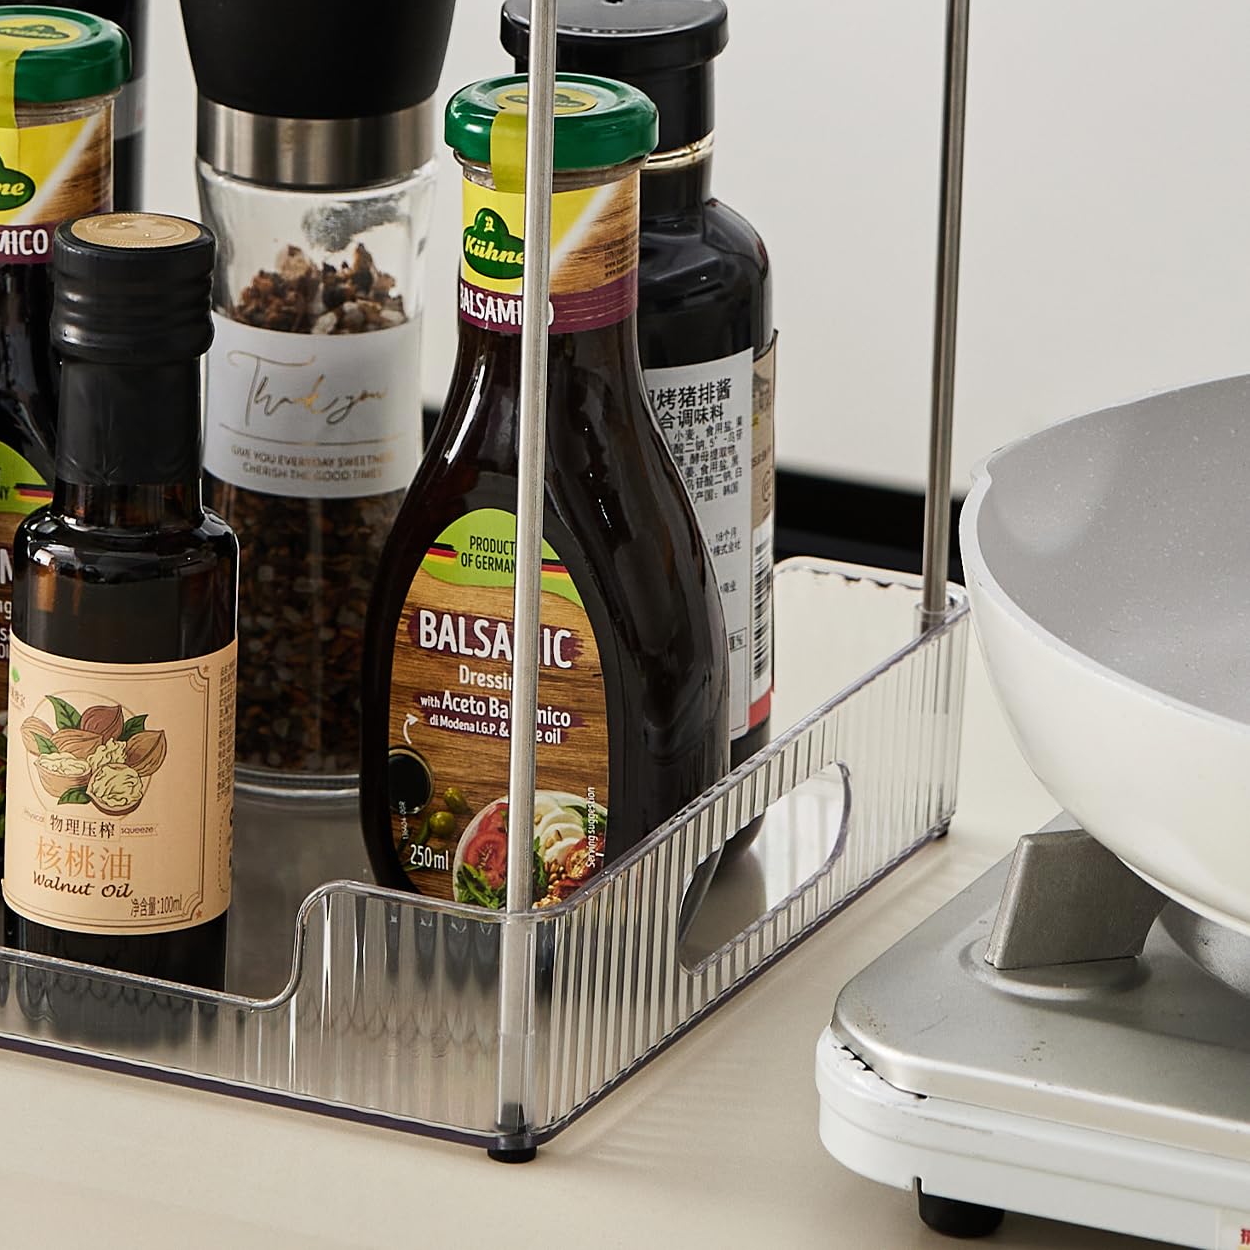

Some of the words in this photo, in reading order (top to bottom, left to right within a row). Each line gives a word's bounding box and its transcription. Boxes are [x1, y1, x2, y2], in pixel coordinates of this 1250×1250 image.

[469, 535, 516, 556] PRODUCT
[461, 552, 473, 568] OF
[475, 554, 516, 574] GERMAN
[418, 609, 573, 670] BALSAIC
[459, 664, 513, 690] Dressi
[420, 695, 441, 709] with
[442, 690, 487, 716] Aceto
[429, 714, 439, 726] di
[440, 715, 475, 732] Modena
[499, 721, 510, 737] &
[545, 728, 561, 744] oil
[49, 814, 115, 839] 物理压榨
[36, 836, 134, 882] 核桃油
[33, 870, 96, 896] Walnut
[101, 882, 134, 899] Oil
